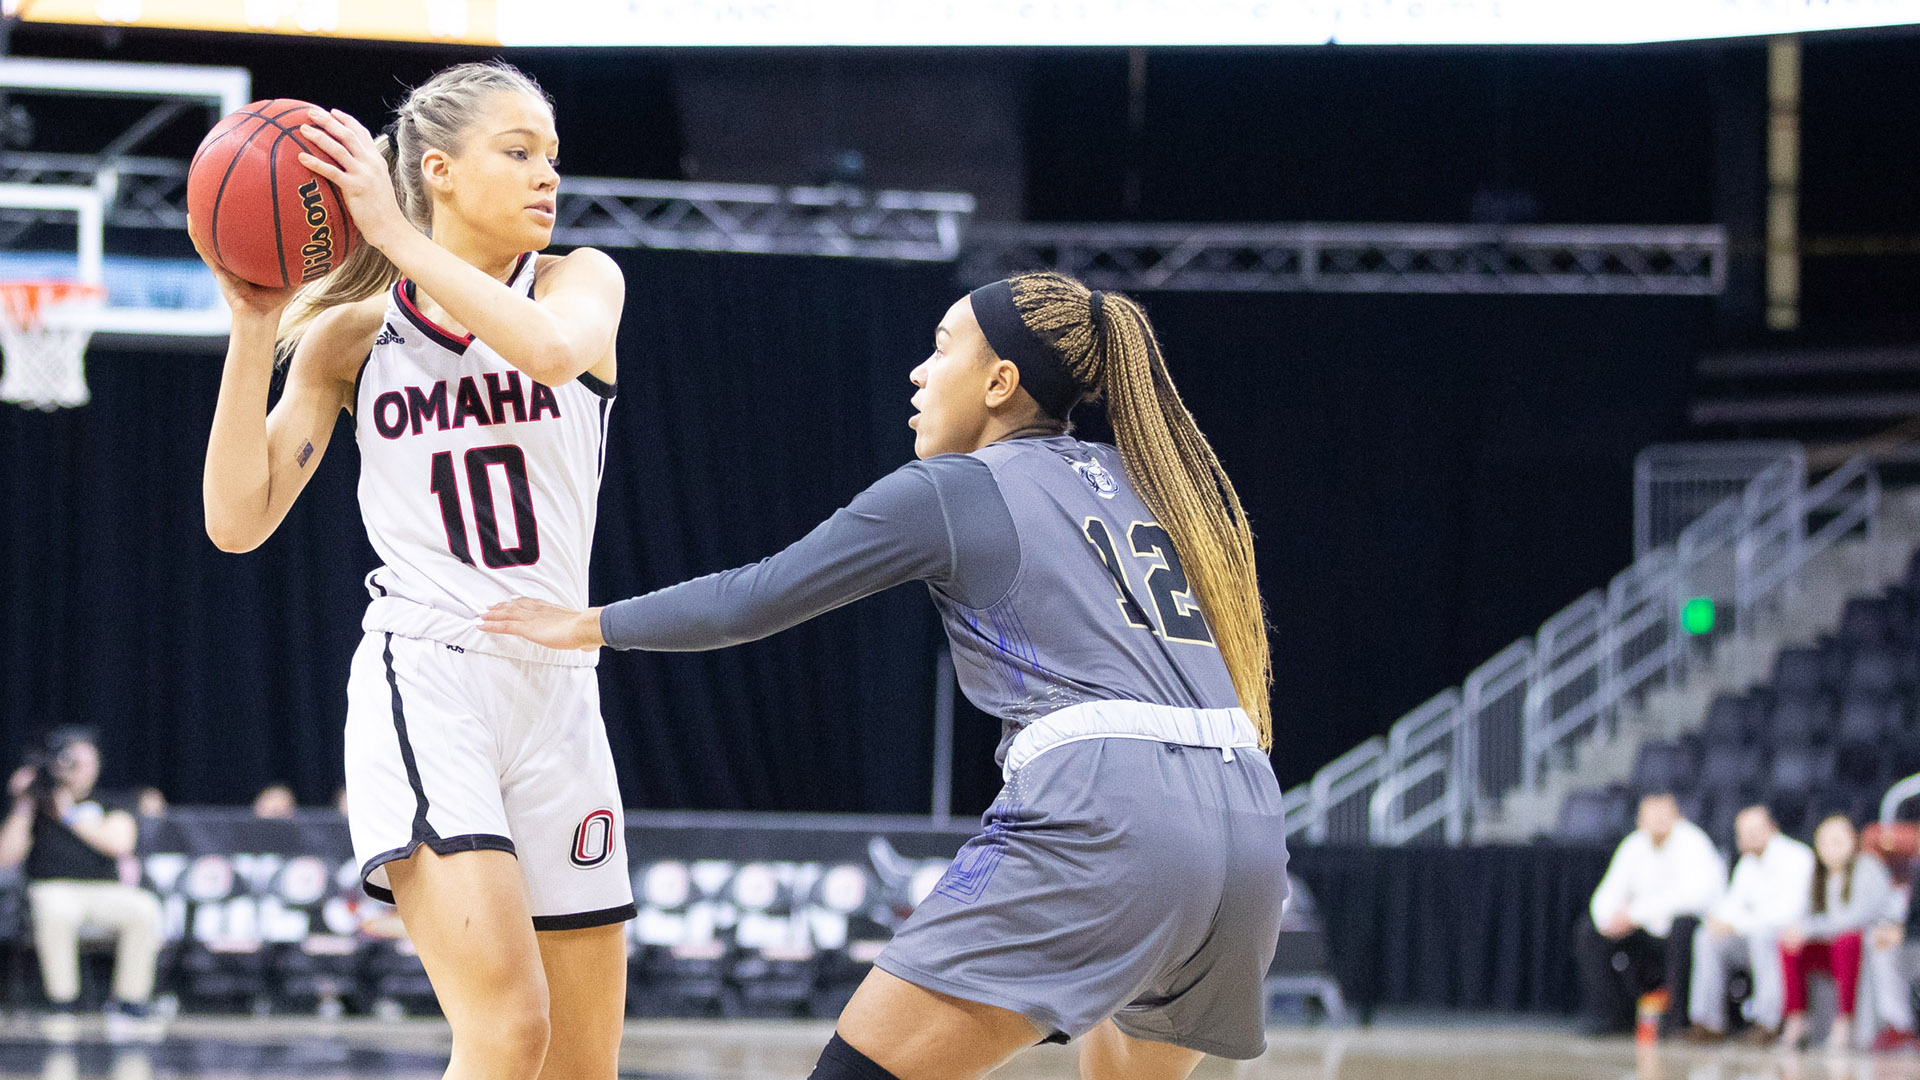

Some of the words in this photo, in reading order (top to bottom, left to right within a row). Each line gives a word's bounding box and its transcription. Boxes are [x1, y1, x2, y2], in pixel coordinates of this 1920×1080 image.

[373, 370, 561, 440] OMAHA
[430, 444, 540, 569] 10
[1083, 515, 1216, 648] 12
